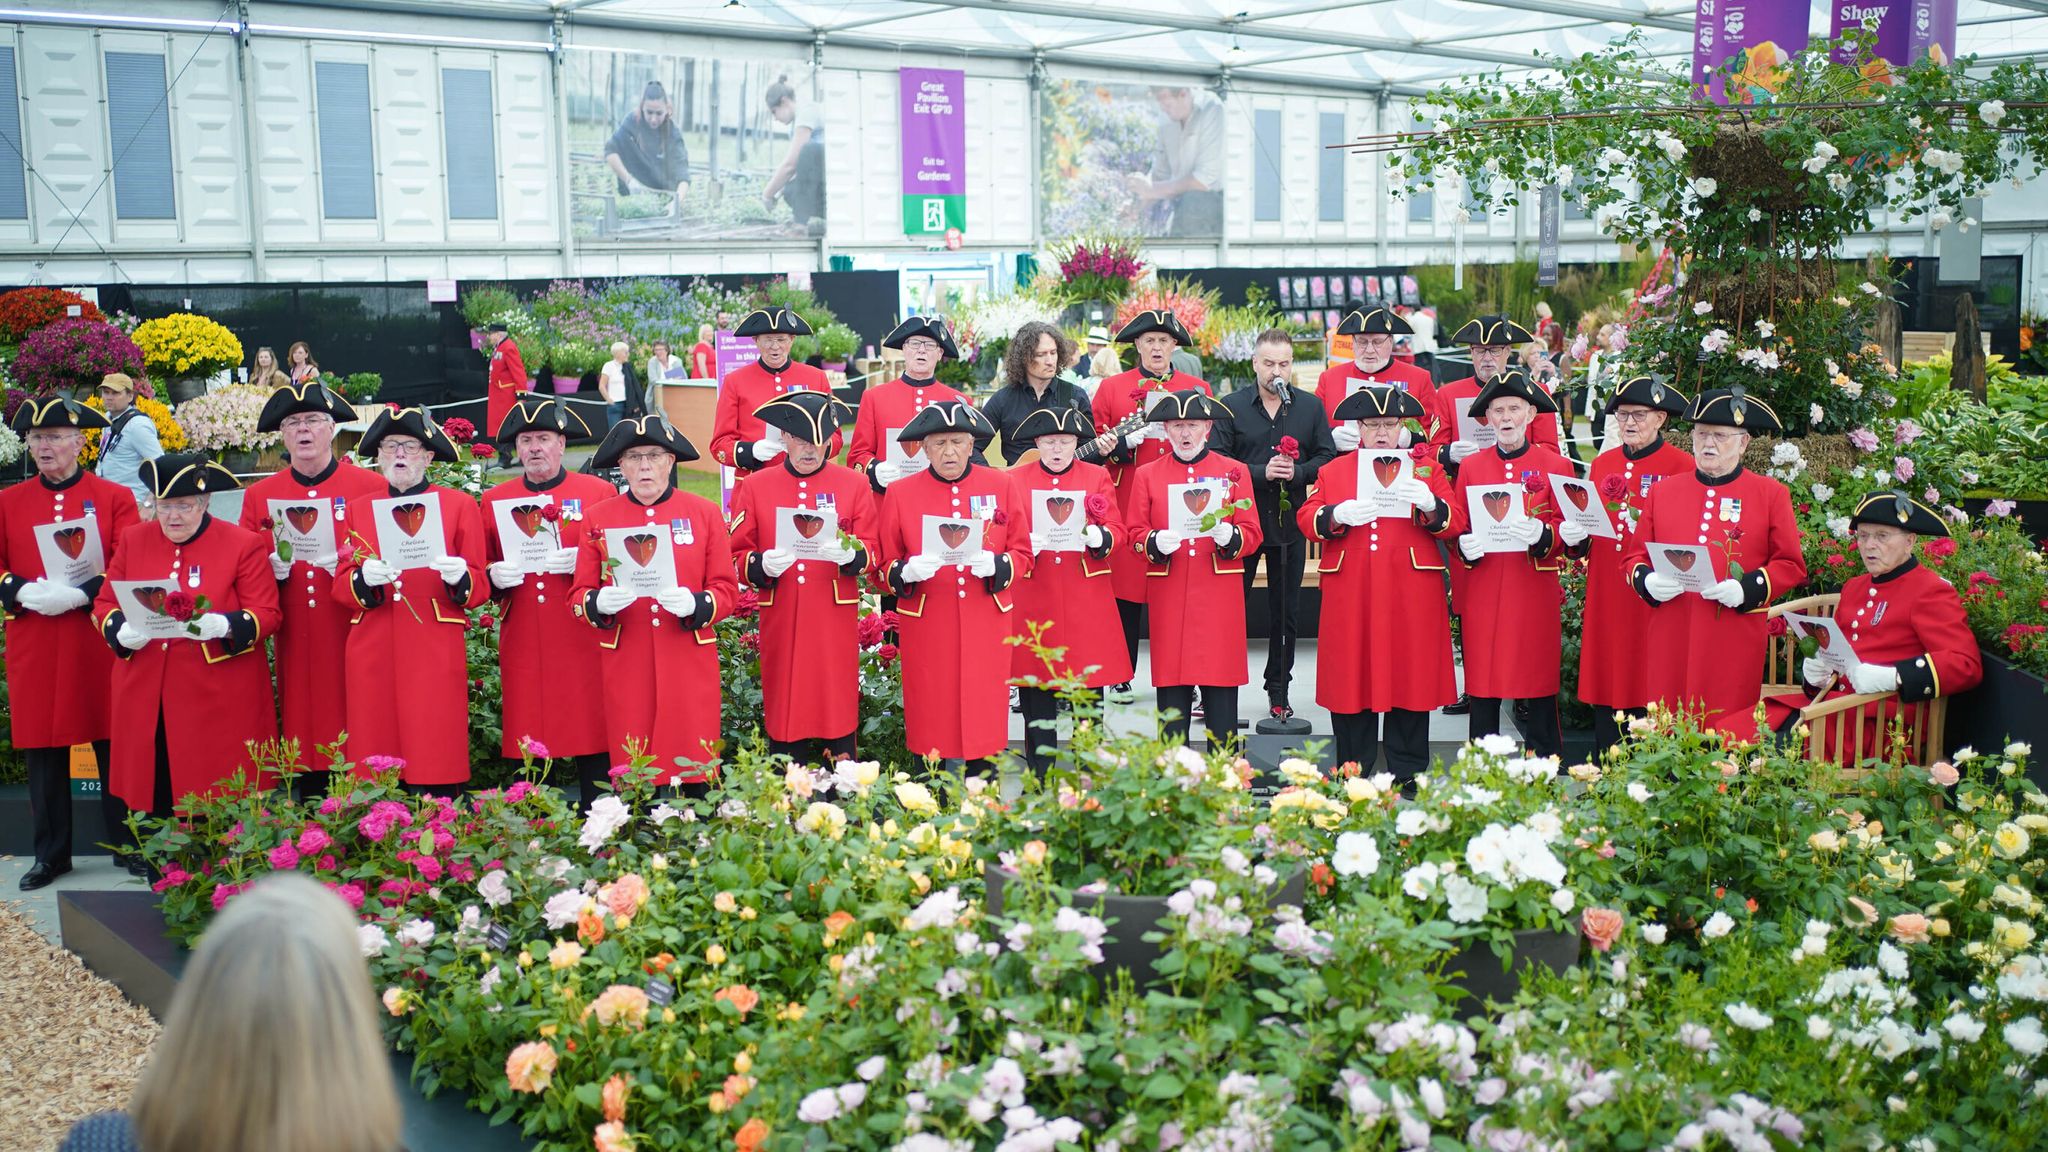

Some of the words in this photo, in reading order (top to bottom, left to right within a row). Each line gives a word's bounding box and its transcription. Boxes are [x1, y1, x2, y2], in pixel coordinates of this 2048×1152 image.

[1840, 4, 1888, 21] Show
[920, 82, 944, 92] Great
[916, 92, 950, 104] Pavilion
[914, 103, 931, 114] Exit
[931, 104, 953, 115] GP10
[923, 156, 936, 166] Exit
[936, 158, 946, 166] to
[917, 170, 952, 182] Gardens
[744, 352, 756, 360] this
[81, 782, 102, 790] 202
